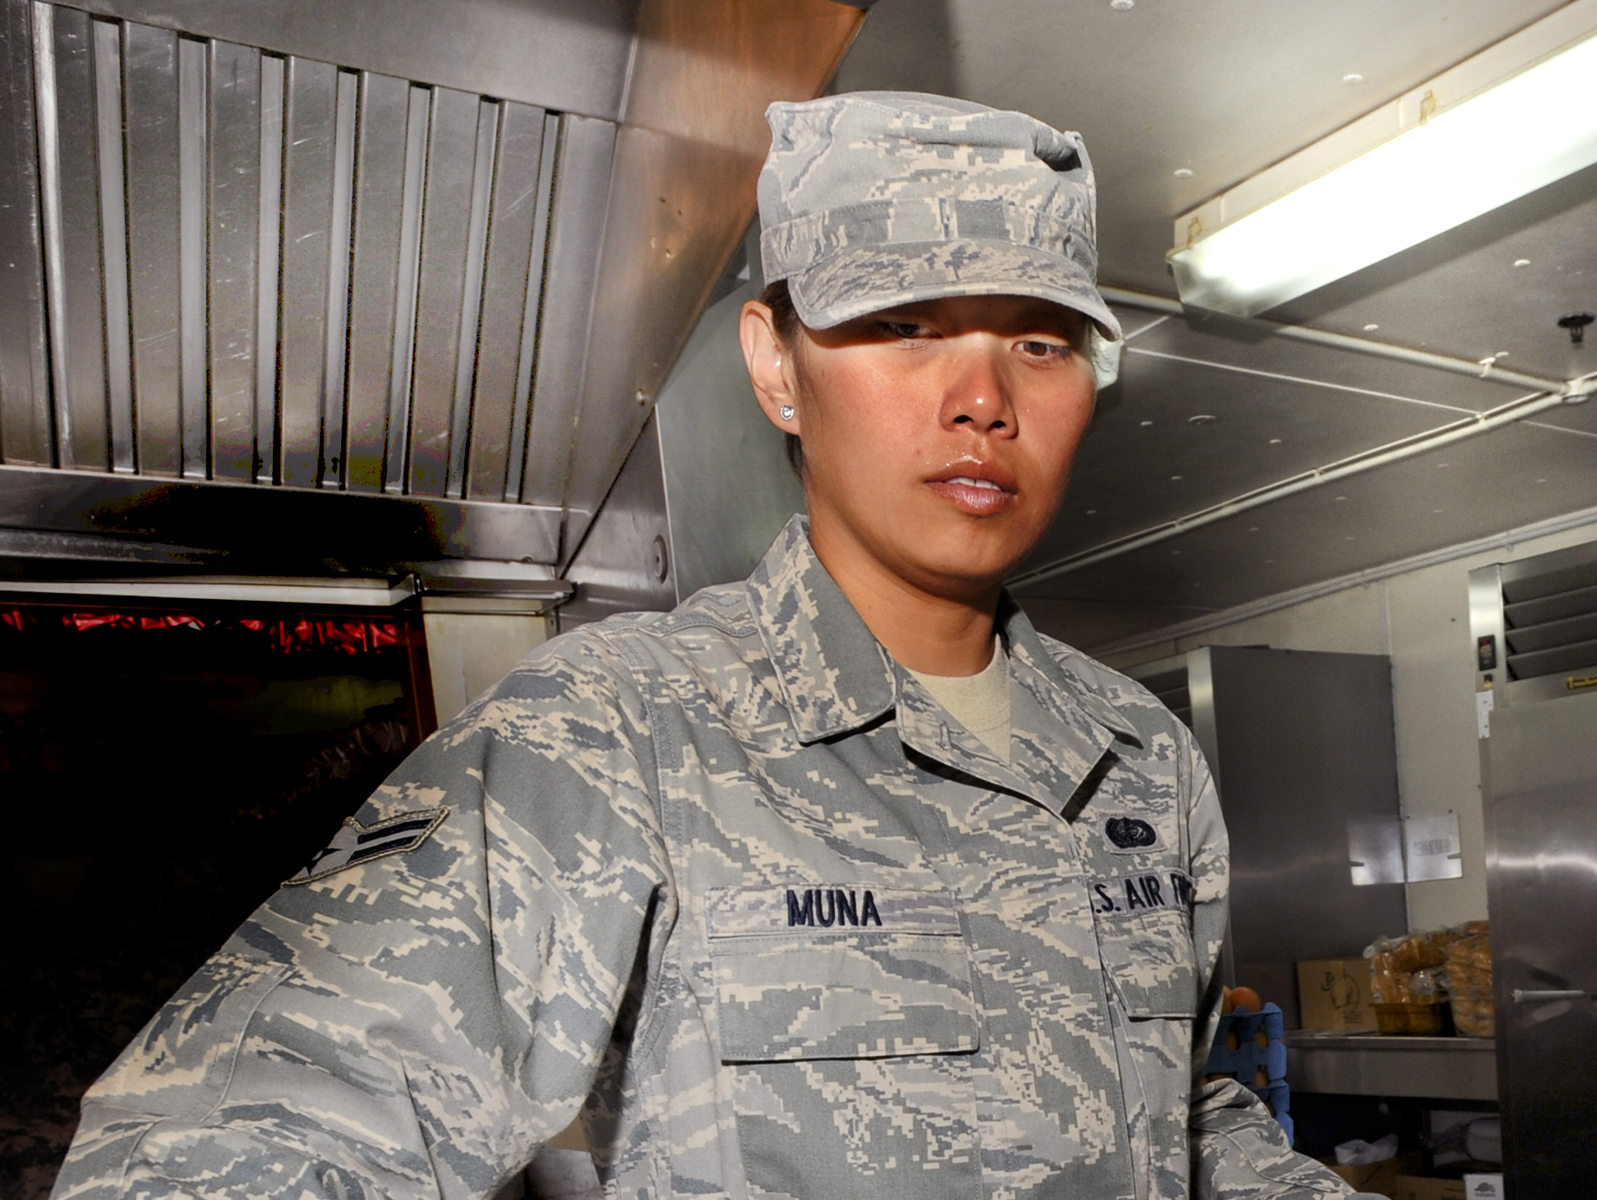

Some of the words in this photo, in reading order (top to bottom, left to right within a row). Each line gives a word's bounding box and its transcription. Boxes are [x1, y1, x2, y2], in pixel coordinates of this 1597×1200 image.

[787, 889, 882, 927] MUNA
[1090, 883, 1122, 914] .S.
[1125, 874, 1165, 910] AIR
